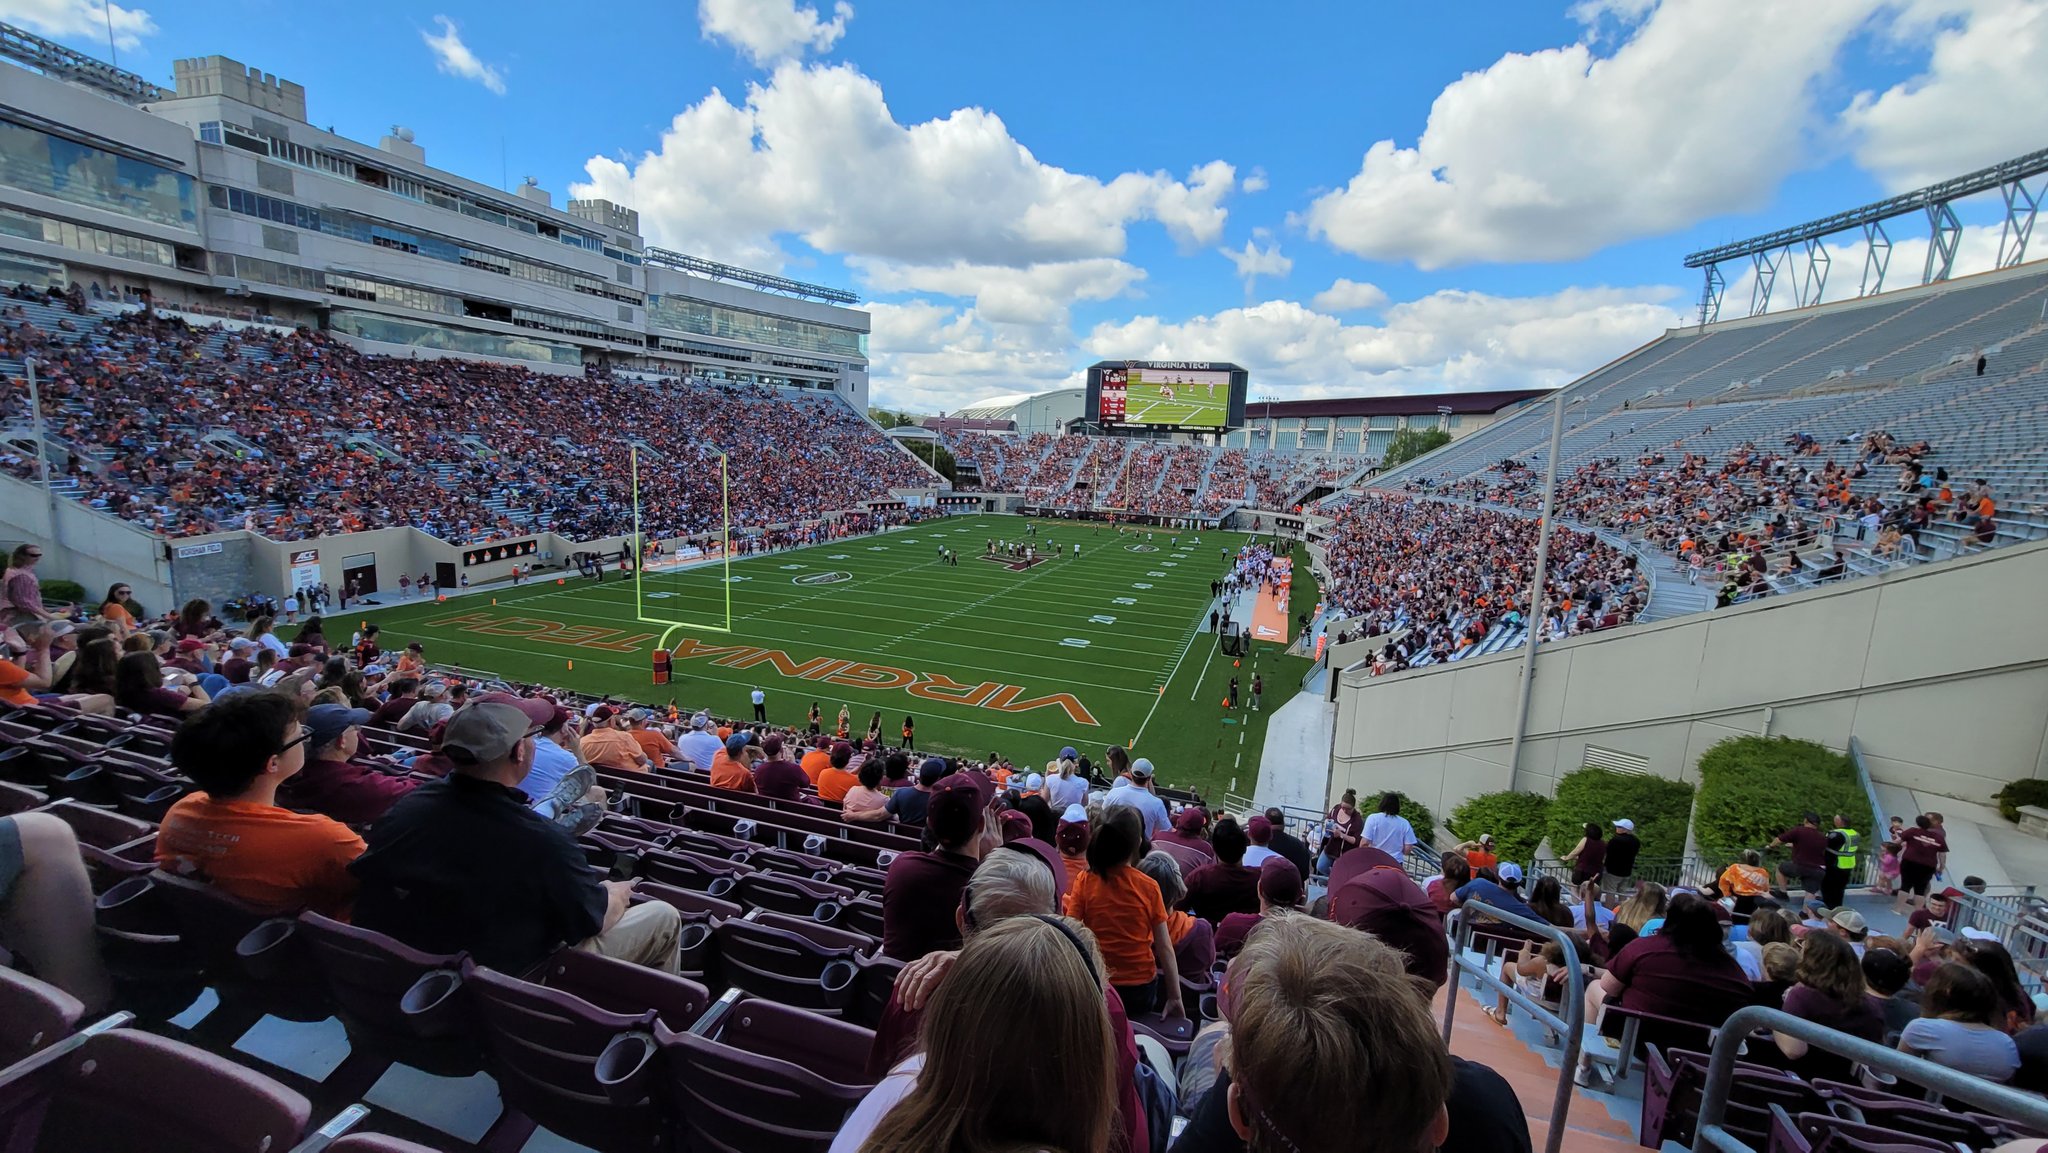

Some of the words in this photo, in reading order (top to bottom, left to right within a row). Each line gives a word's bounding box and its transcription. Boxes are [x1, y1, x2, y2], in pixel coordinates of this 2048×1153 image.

[1147, 361, 1186, 369] VIRGINIA
[1188, 361, 1210, 369] TECH
[296, 551, 315, 560] ACC
[426, 614, 656, 654] TECH
[1058, 638, 1091, 648] 10
[674, 640, 1102, 728] VIRGINIA
